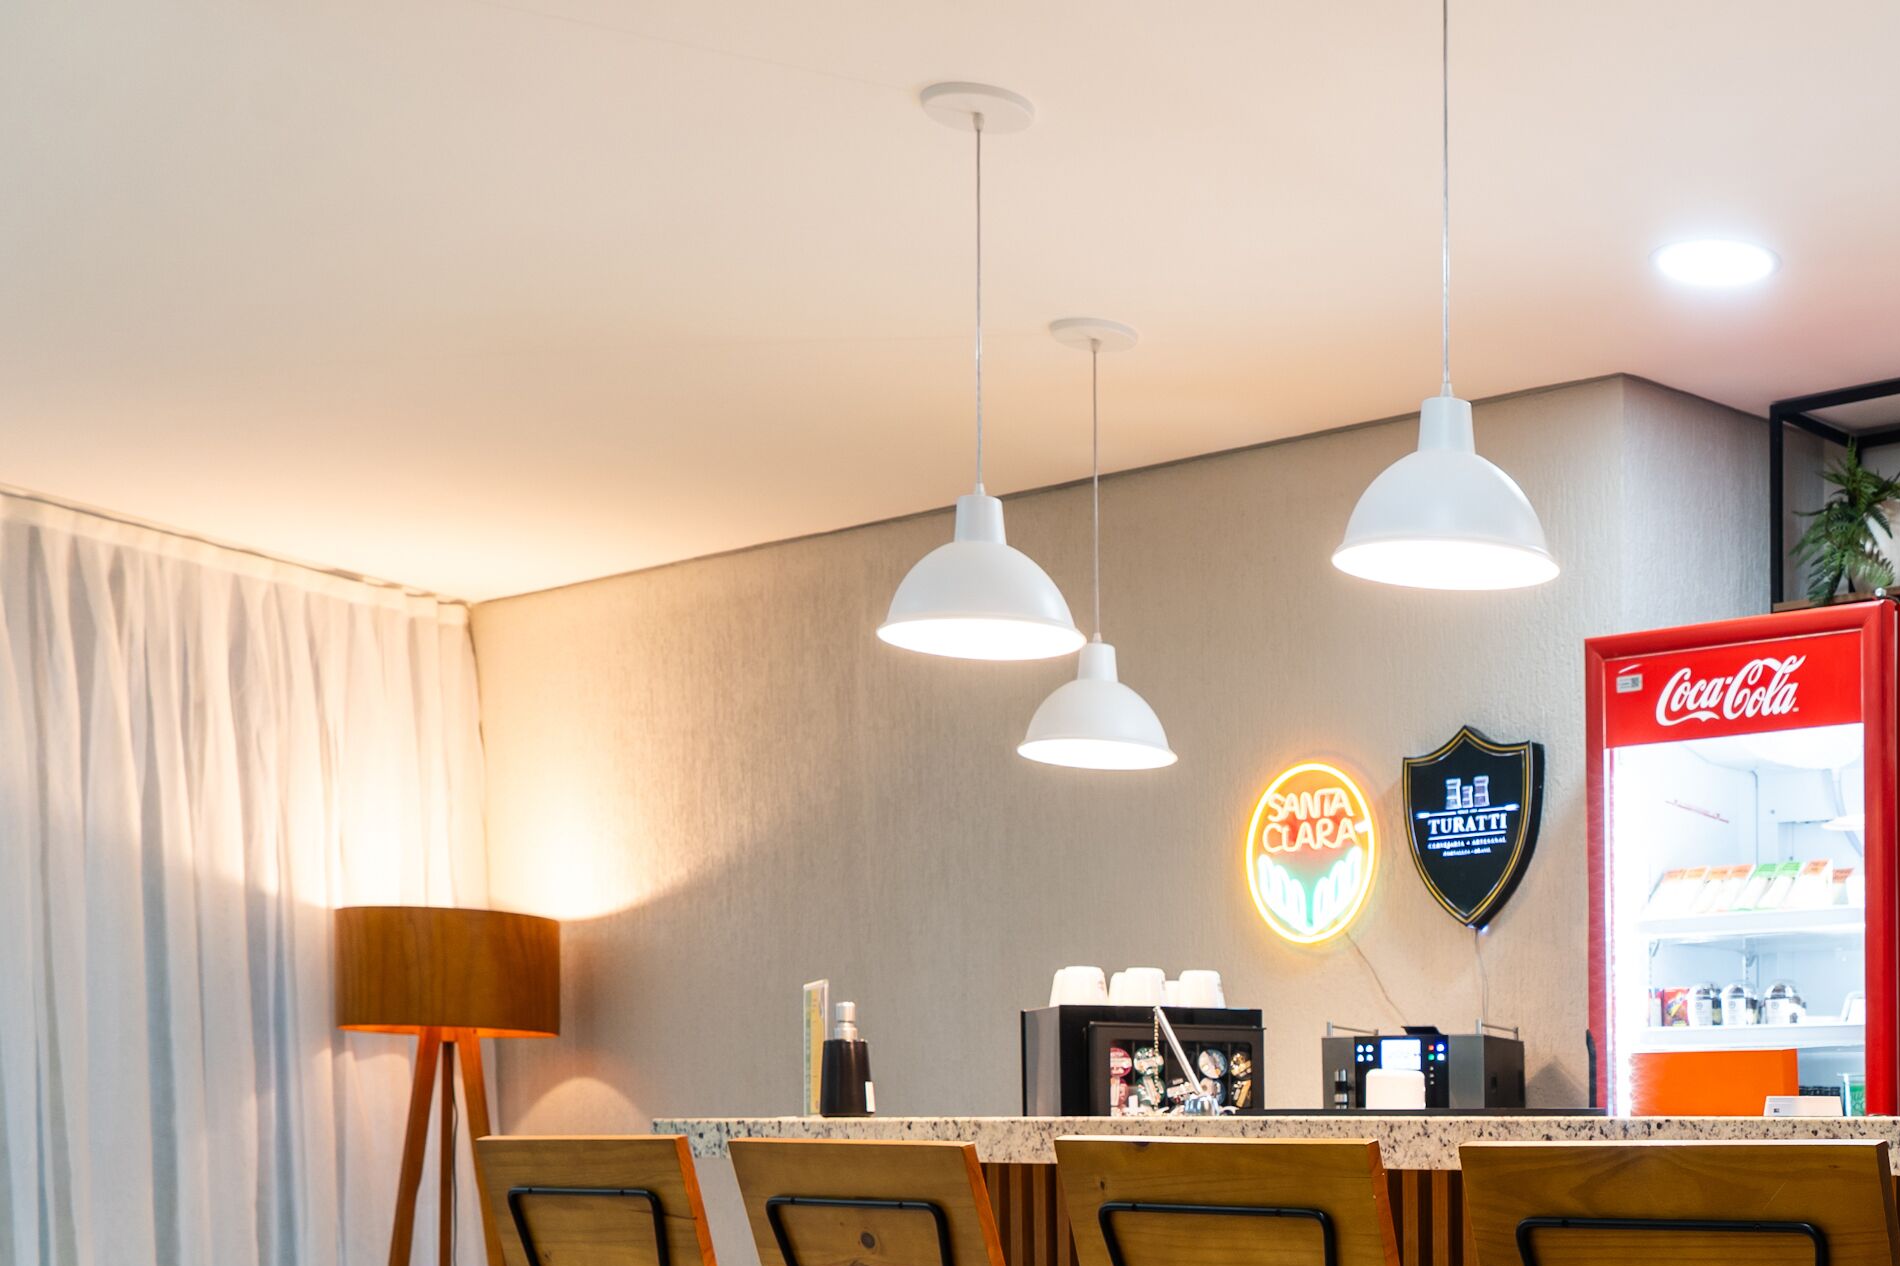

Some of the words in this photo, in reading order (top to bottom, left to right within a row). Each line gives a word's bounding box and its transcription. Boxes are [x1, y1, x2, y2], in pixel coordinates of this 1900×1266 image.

[1656, 655, 1807, 726] Coca-Cola
[1267, 787, 1355, 823] SANTA
[1262, 817, 1358, 853] CLARA
[1428, 813, 1507, 835] TURATTI
